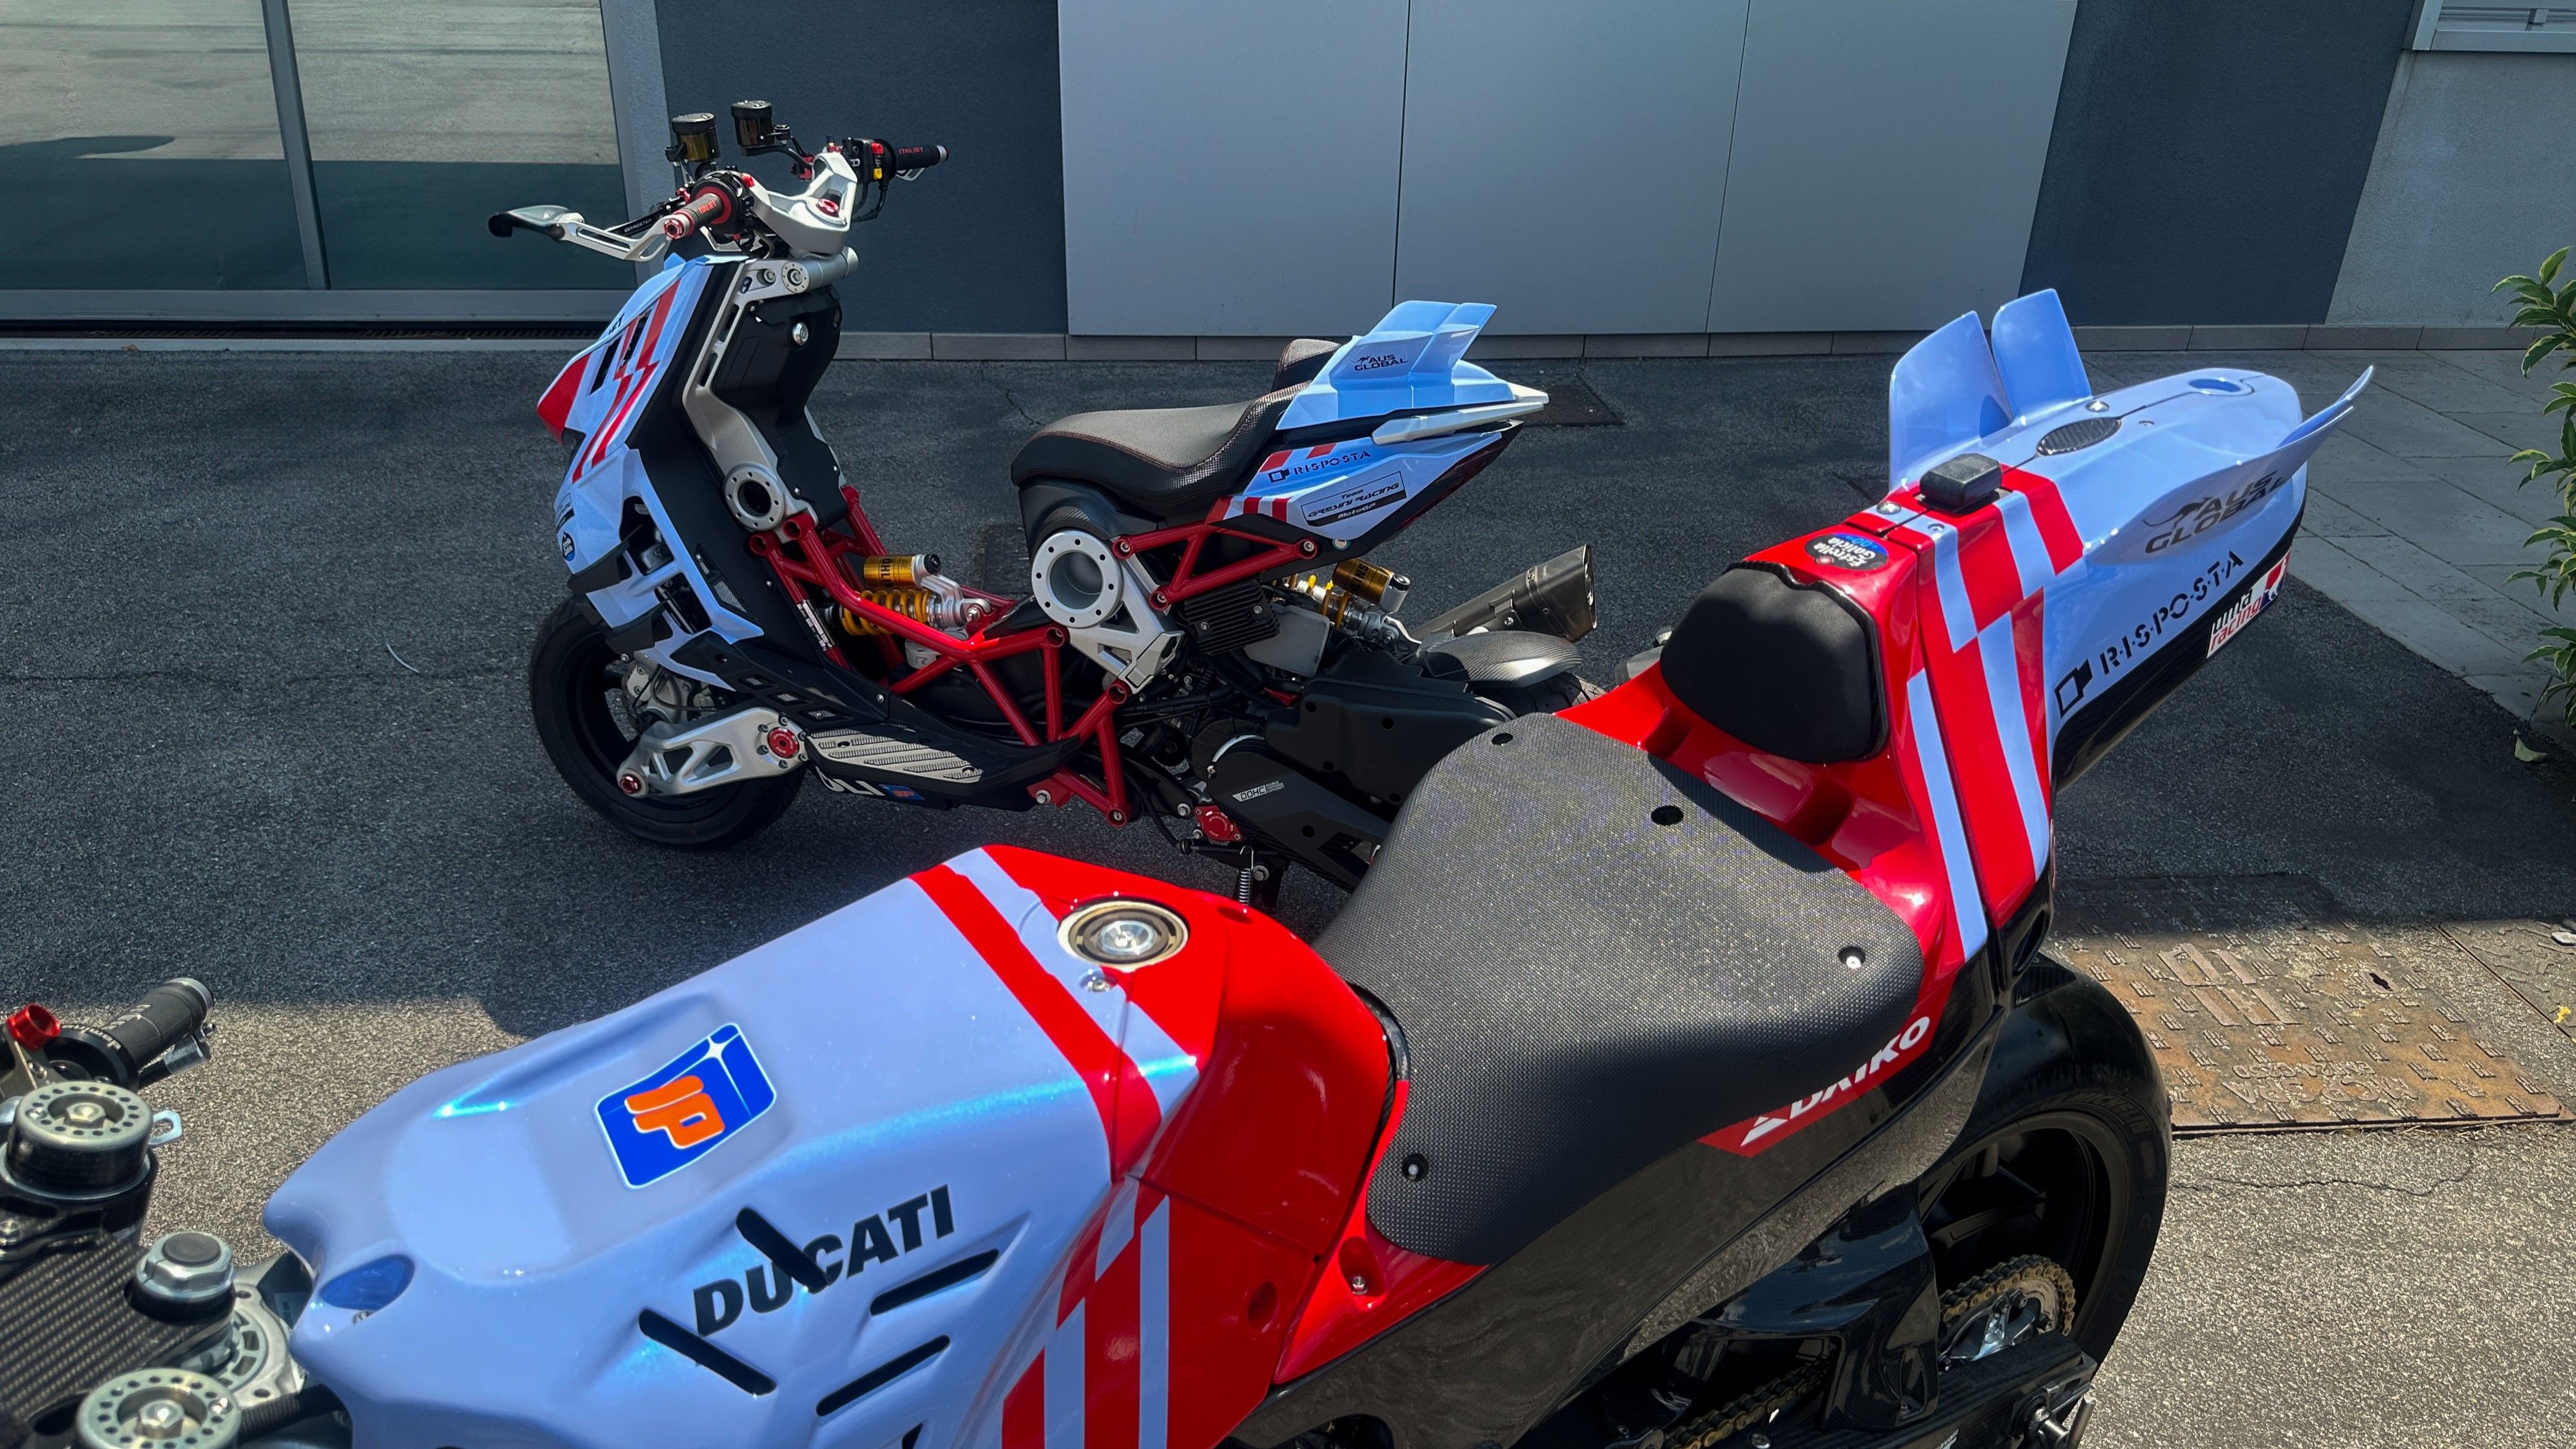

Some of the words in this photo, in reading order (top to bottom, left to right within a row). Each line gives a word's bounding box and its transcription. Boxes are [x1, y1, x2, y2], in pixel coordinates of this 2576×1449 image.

[898, 146, 924, 155] ITALJET
[1354, 358, 1408, 371] GLOBAL
[1369, 354, 1396, 364] AUS
[1340, 489, 1364, 500] Team
[2194, 470, 2278, 521] AUS
[2145, 477, 2285, 553] GLOBAL
[2210, 595, 2262, 652] racing
[1240, 786, 1266, 800] DOHC
[693, 1184, 954, 1338] DUCATI
